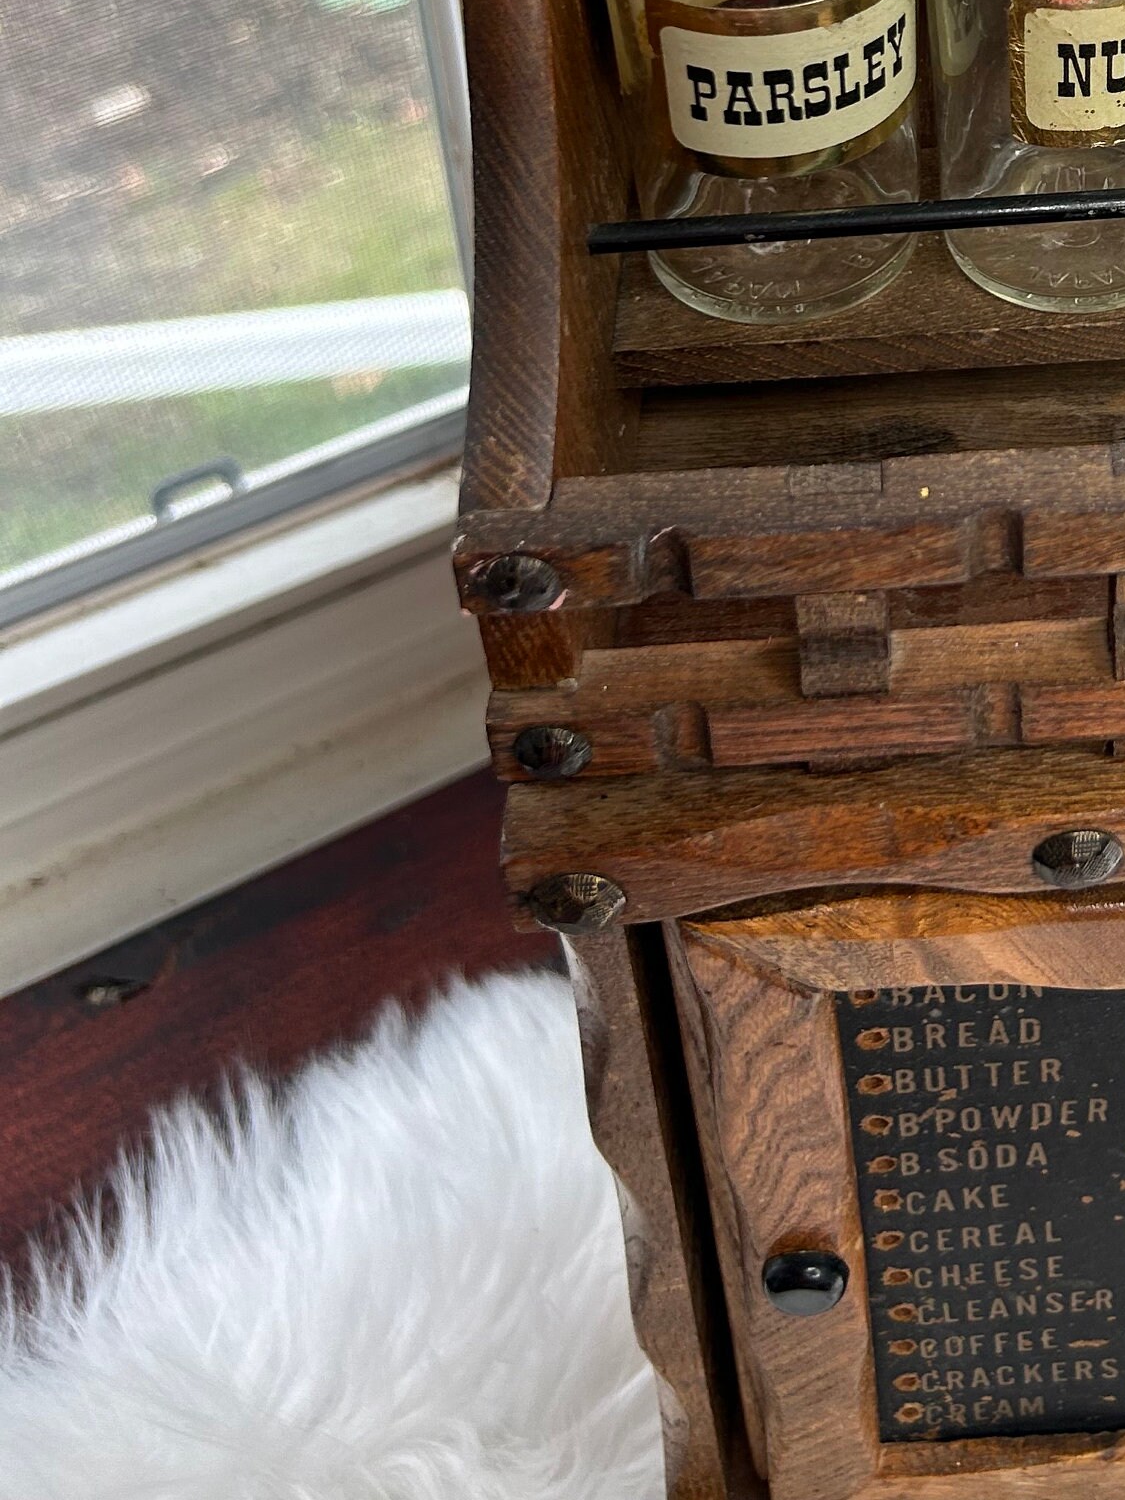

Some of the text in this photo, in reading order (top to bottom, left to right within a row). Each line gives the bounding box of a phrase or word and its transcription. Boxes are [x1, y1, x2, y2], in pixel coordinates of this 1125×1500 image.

[686, 12, 908, 127] PARSLEY
[892, 1017, 1042, 1052] BREAD
[895, 1057, 1062, 1094] BUTTER
[906, 1183, 1009, 1215] CAKE
[909, 1220, 1061, 1253] CEREAL
[914, 1255, 1064, 1289] CHEESE
[917, 1288, 1113, 1325] CLEANSER
[920, 1327, 1059, 1359] COFFEE
[922, 1357, 1119, 1392] CRACKERS
[925, 1395, 1045, 1425] CREAM
